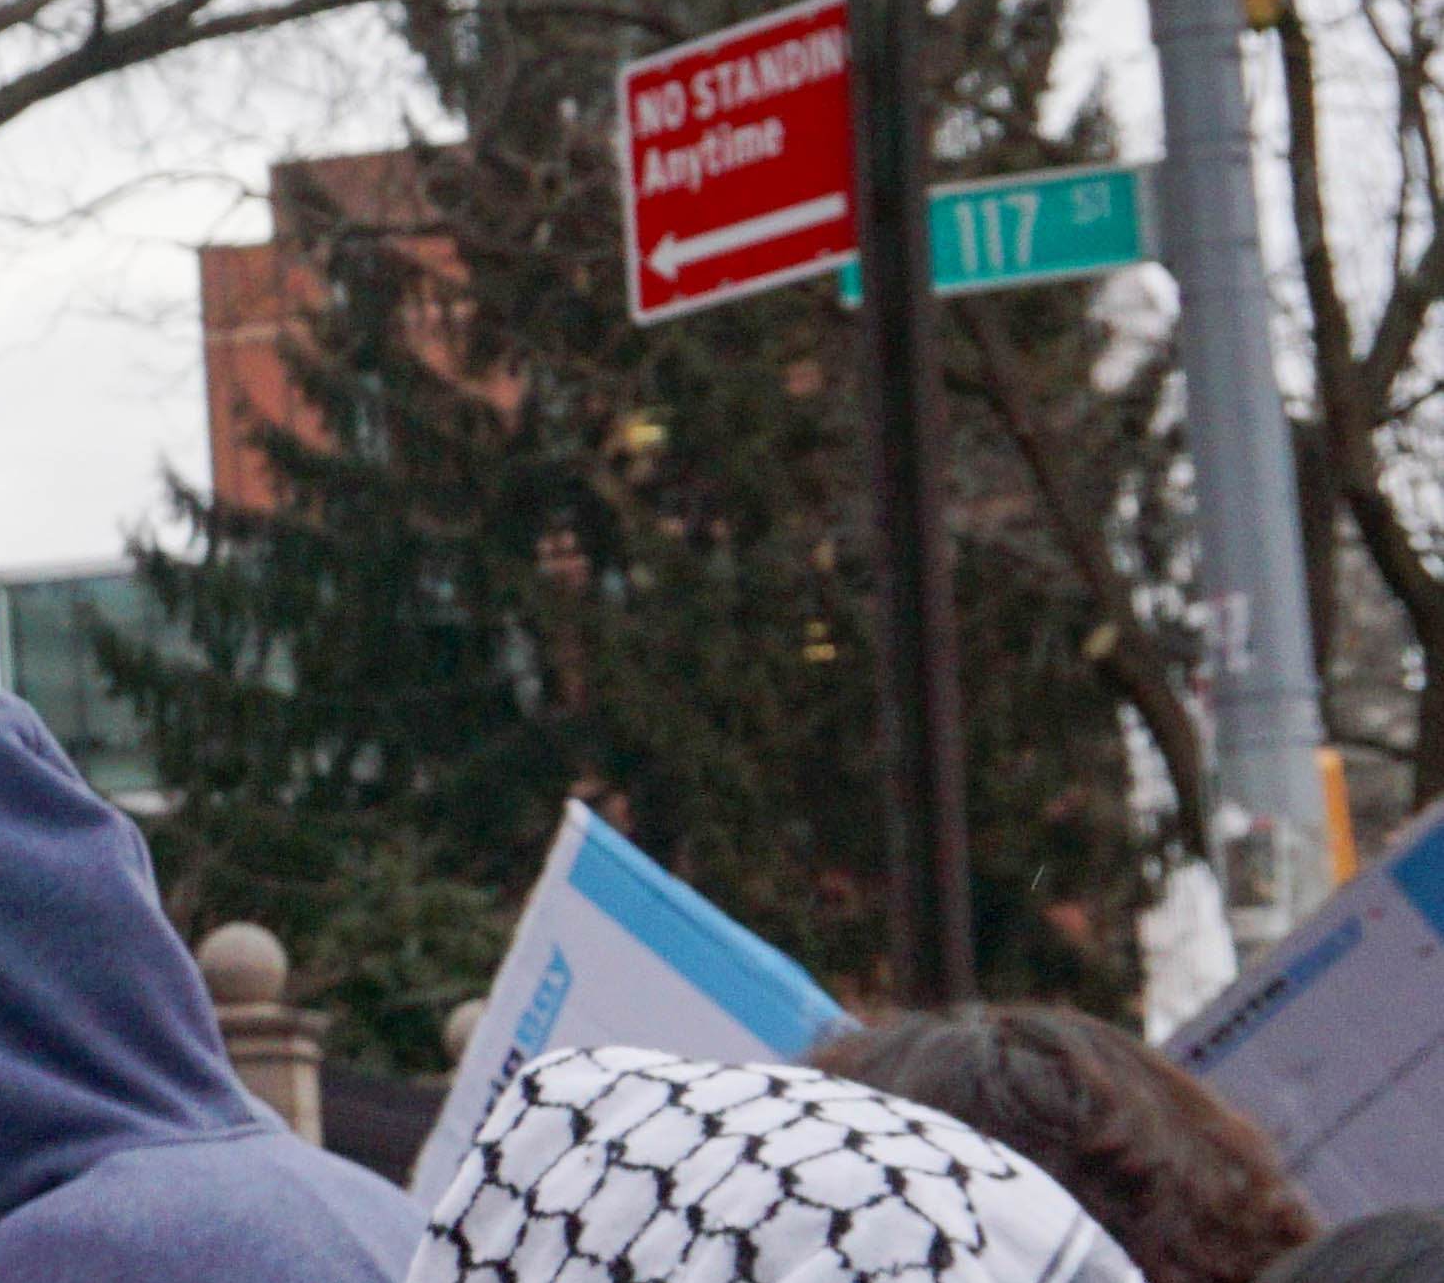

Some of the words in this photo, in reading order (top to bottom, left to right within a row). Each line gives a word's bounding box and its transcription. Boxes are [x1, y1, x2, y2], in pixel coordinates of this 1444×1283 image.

[635, 78, 688, 138] NO
[689, 25, 846, 122] STANDIN
[640, 116, 786, 198] Anytime
[954, 192, 1040, 276] 117
